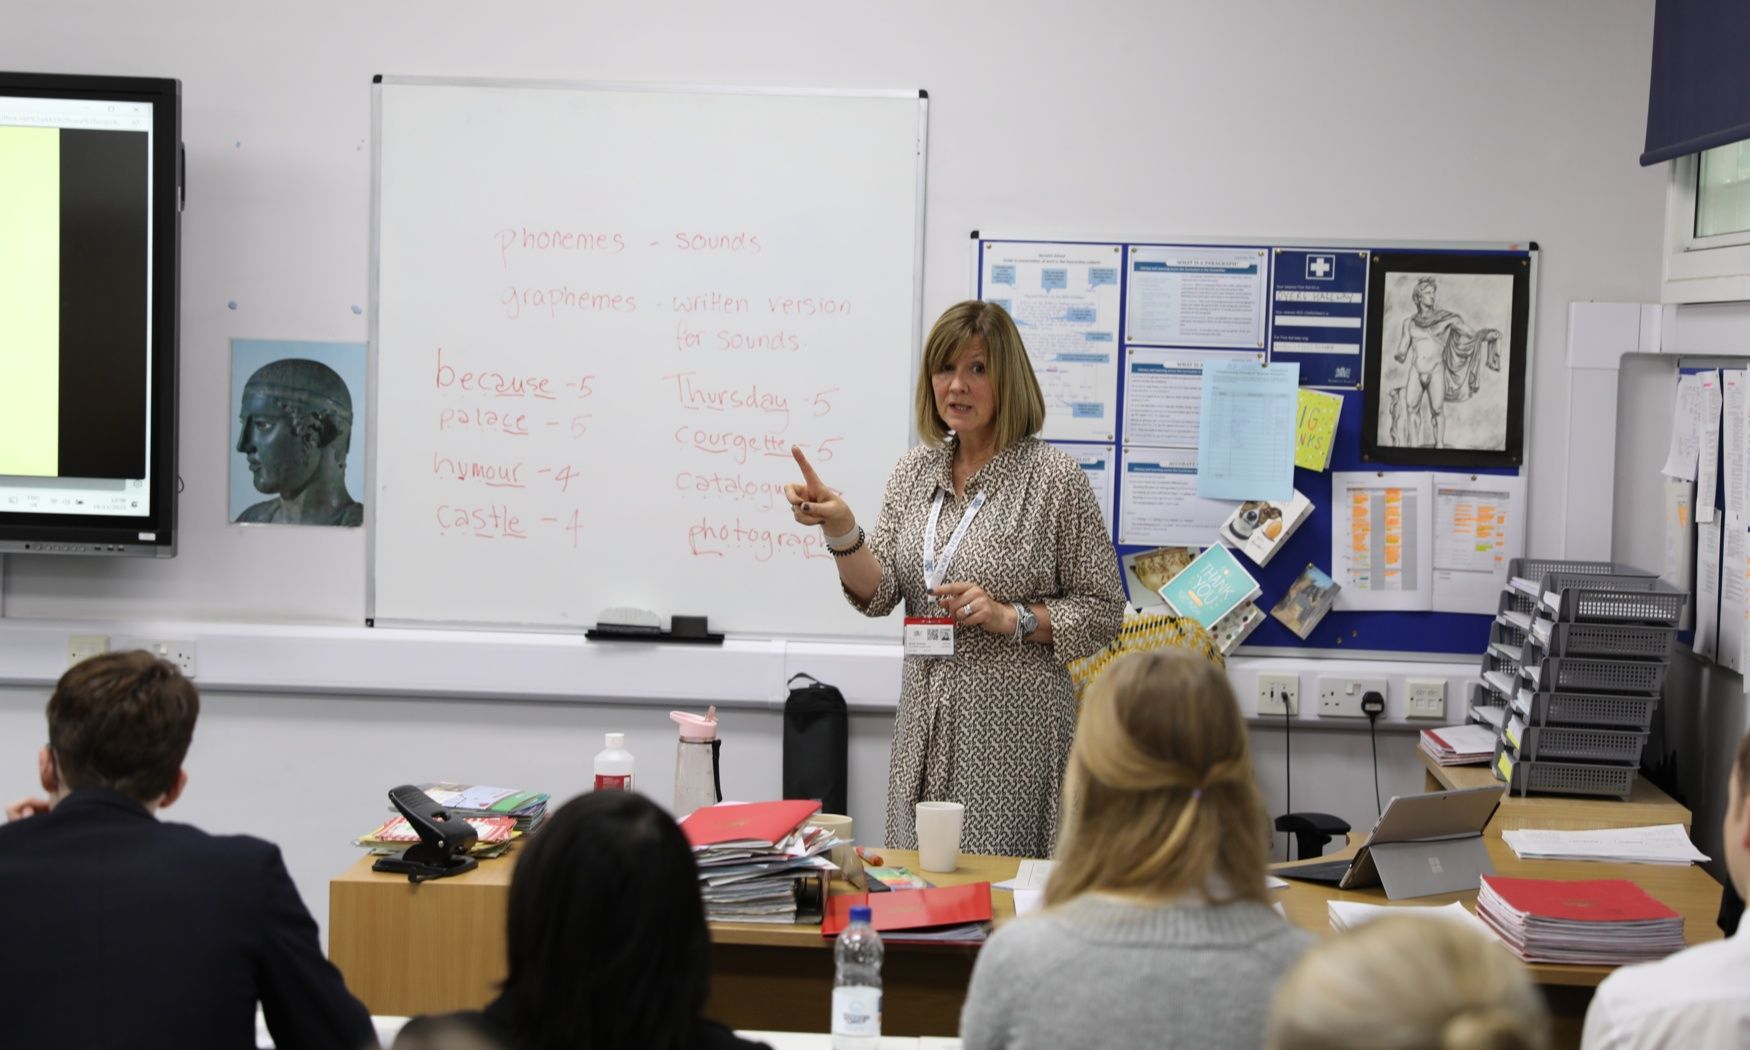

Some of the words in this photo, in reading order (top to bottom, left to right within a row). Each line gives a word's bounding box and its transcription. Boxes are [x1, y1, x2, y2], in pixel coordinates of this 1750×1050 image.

[495, 227, 625, 269] phonemes
[675, 231, 761, 253] sounds
[501, 285, 637, 320] graphemes
[671, 291, 750, 314] written
[767, 296, 852, 316] version
[675, 318, 706, 352] for
[435, 347, 555, 398] because
[662, 371, 790, 434] Thursday
[1299, 403, 1321, 434] IG
[439, 407, 529, 436] palace
[675, 426, 790, 465] courgette
[1298, 432, 1324, 450] NKS
[433, 451, 525, 487] humour
[676, 471, 786, 512] catalogu
[436, 503, 527, 539] castle
[1193, 573, 1220, 605] YOU
[1201, 561, 1237, 601] THANK
